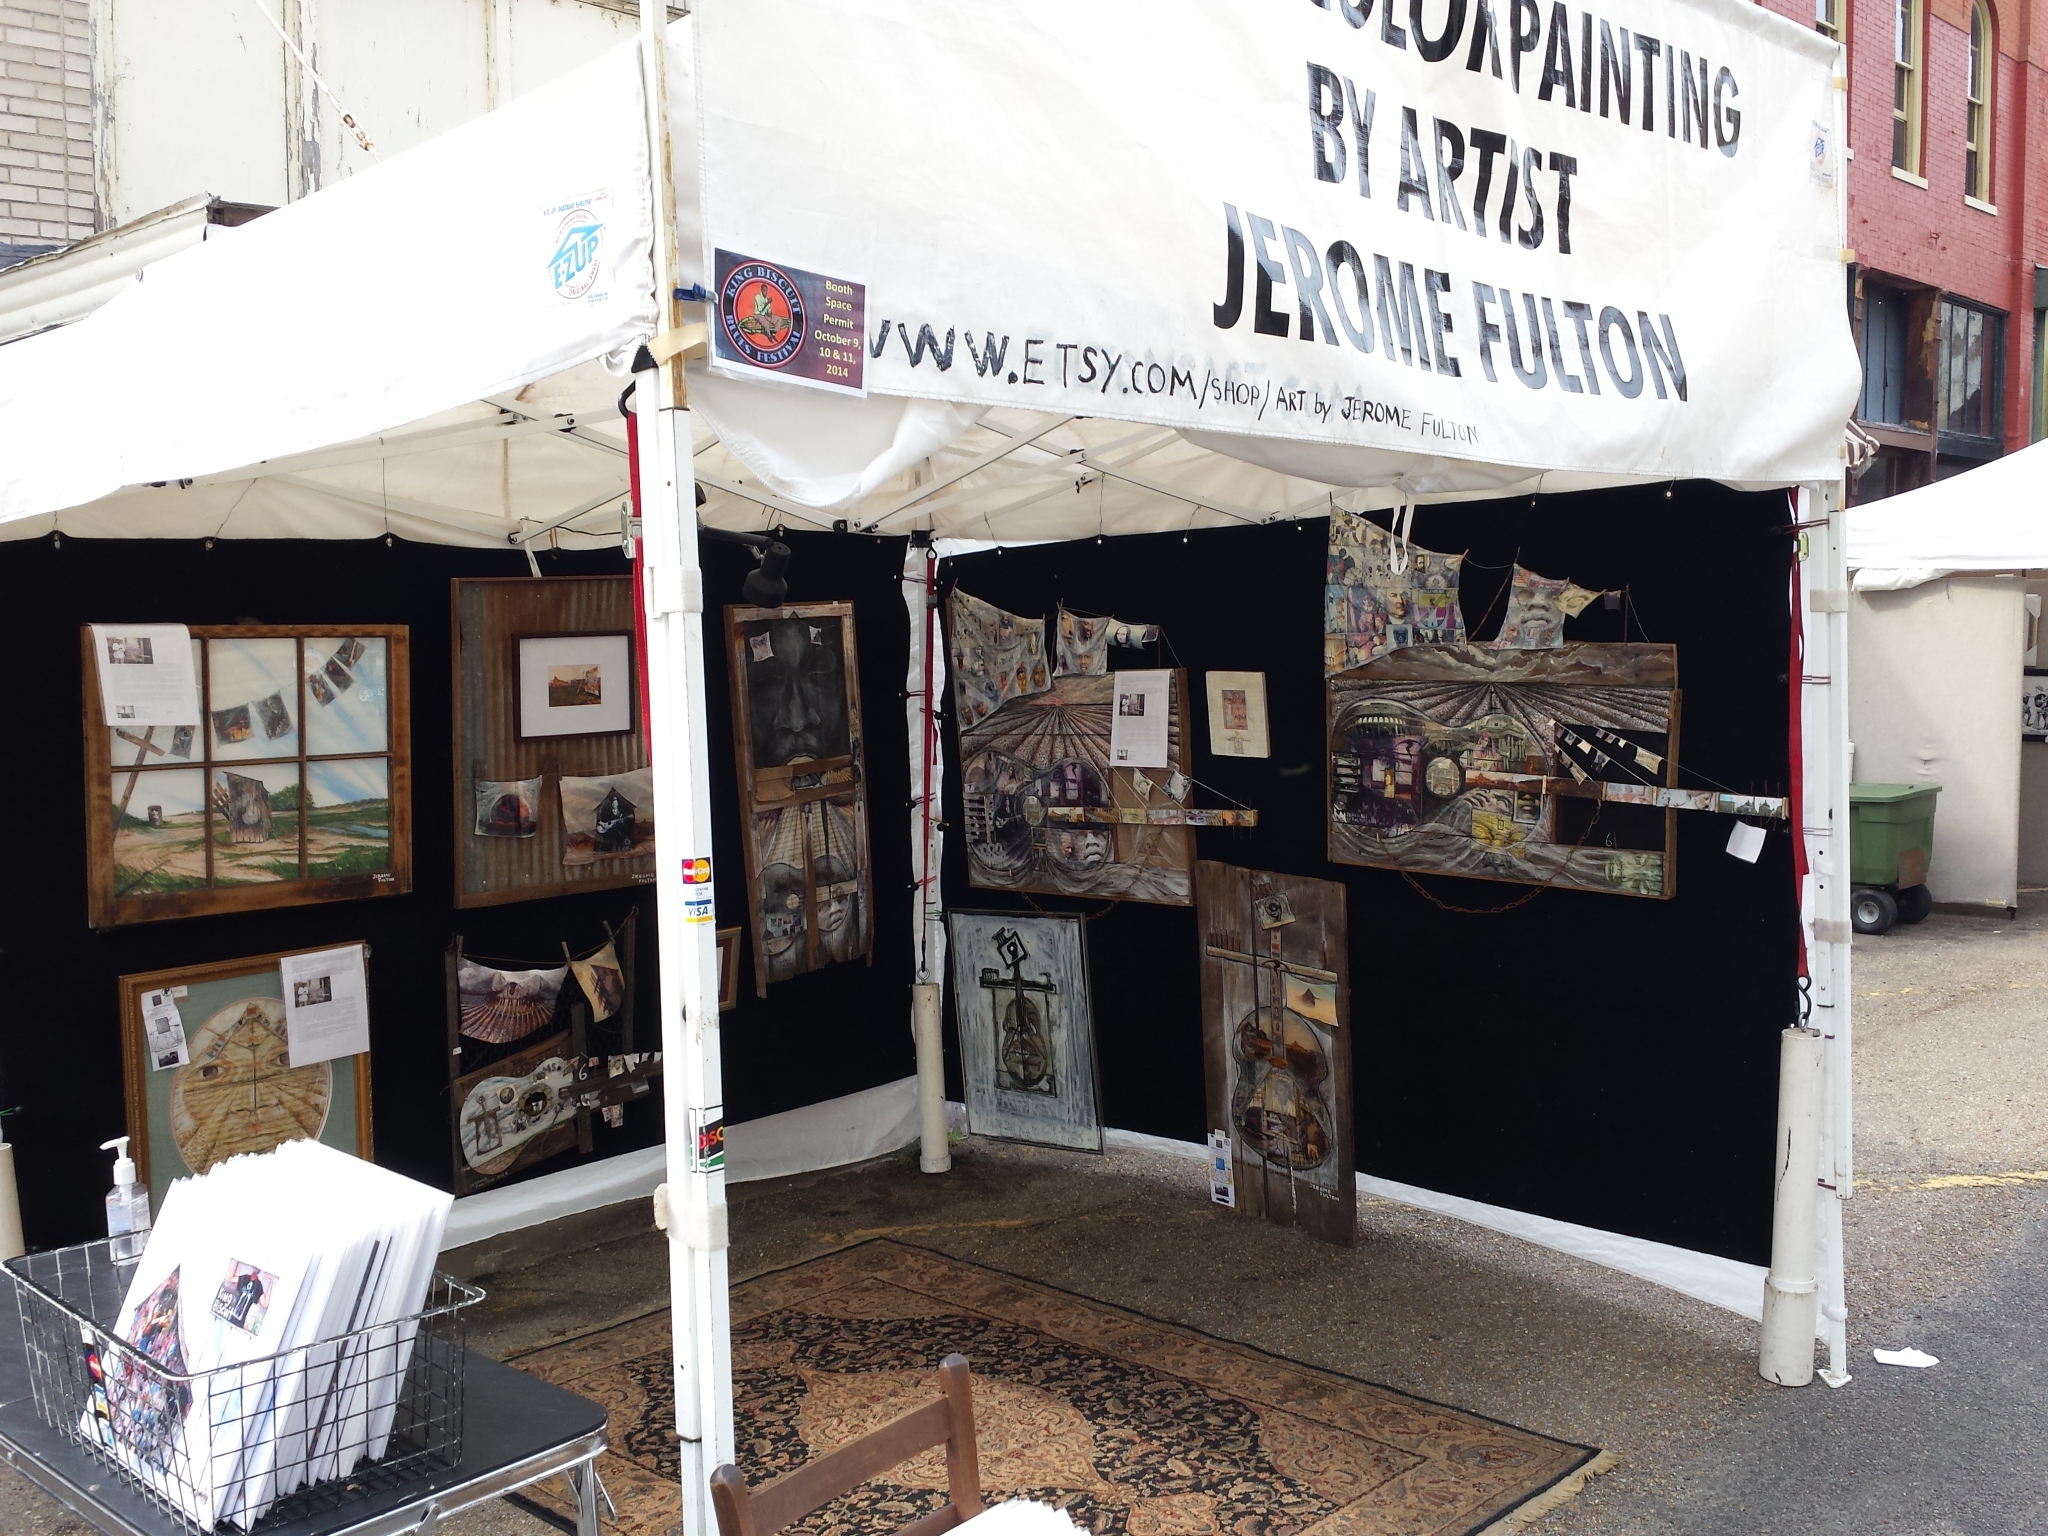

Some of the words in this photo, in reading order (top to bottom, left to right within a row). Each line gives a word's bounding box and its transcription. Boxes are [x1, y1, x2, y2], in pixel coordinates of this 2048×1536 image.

[1307, 61, 1376, 199] BY
[1397, 105, 1577, 255] ARTIST
[726, 267, 753, 298] KING
[757, 266, 802, 315] BISCUIT
[825, 280, 853, 296] Booth
[825, 296, 852, 312] Space
[1213, 202, 1462, 379] JEROME
[1471, 280, 1688, 403] FULTON
[823, 313, 854, 330] Permit
[725, 314, 751, 355] BLUES
[814, 330, 851, 347] October
[853, 337, 862, 351] 9,
[756, 330, 801, 363] FESTIVAL
[819, 347, 831, 358] 10
[832, 349, 841, 360] &
[842, 351, 856, 365] 11,
[826, 364, 849, 378] 2014
[1314, 392, 1332, 424] by
[1341, 395, 1412, 430] JEROME
[1420, 412, 1480, 445] FULTON
[688, 906, 709, 917] VISA
